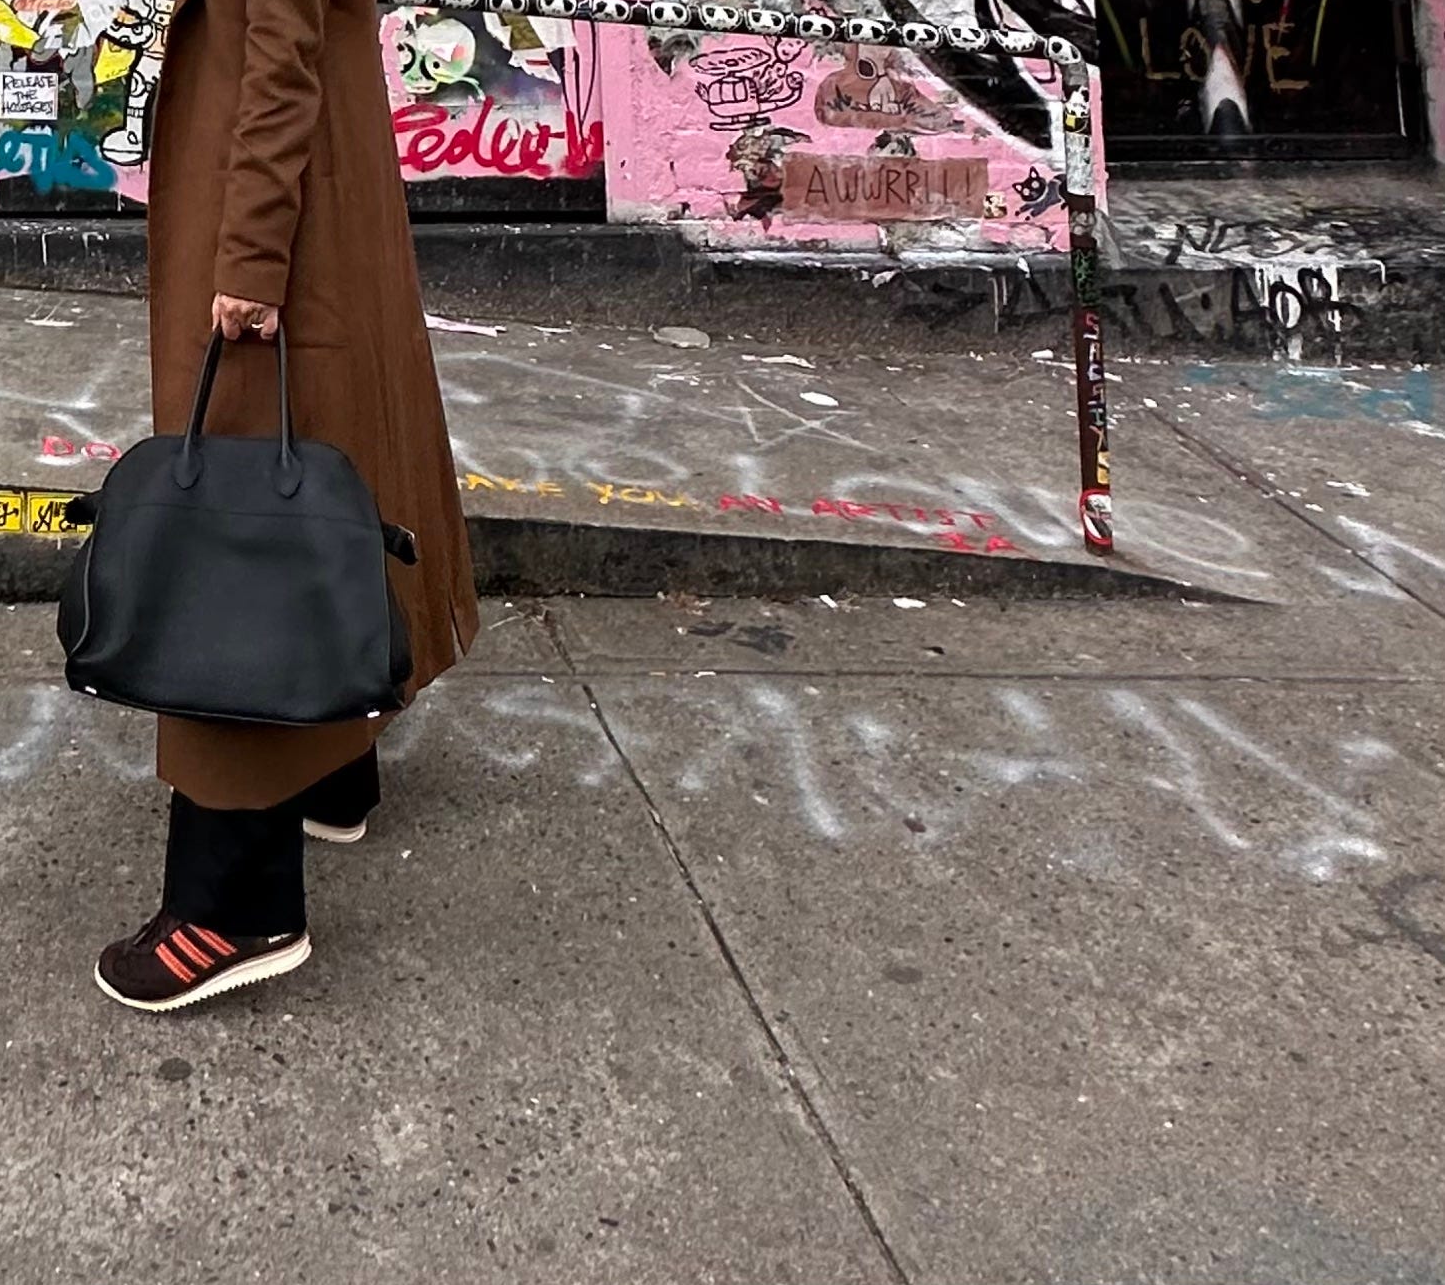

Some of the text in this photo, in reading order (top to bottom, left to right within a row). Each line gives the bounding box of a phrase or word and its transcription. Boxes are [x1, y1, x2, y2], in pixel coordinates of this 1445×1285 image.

[3, 75, 56, 91] RELEASE
[15, 90, 38, 101] THE
[811, 496, 995, 530] ARTIST
